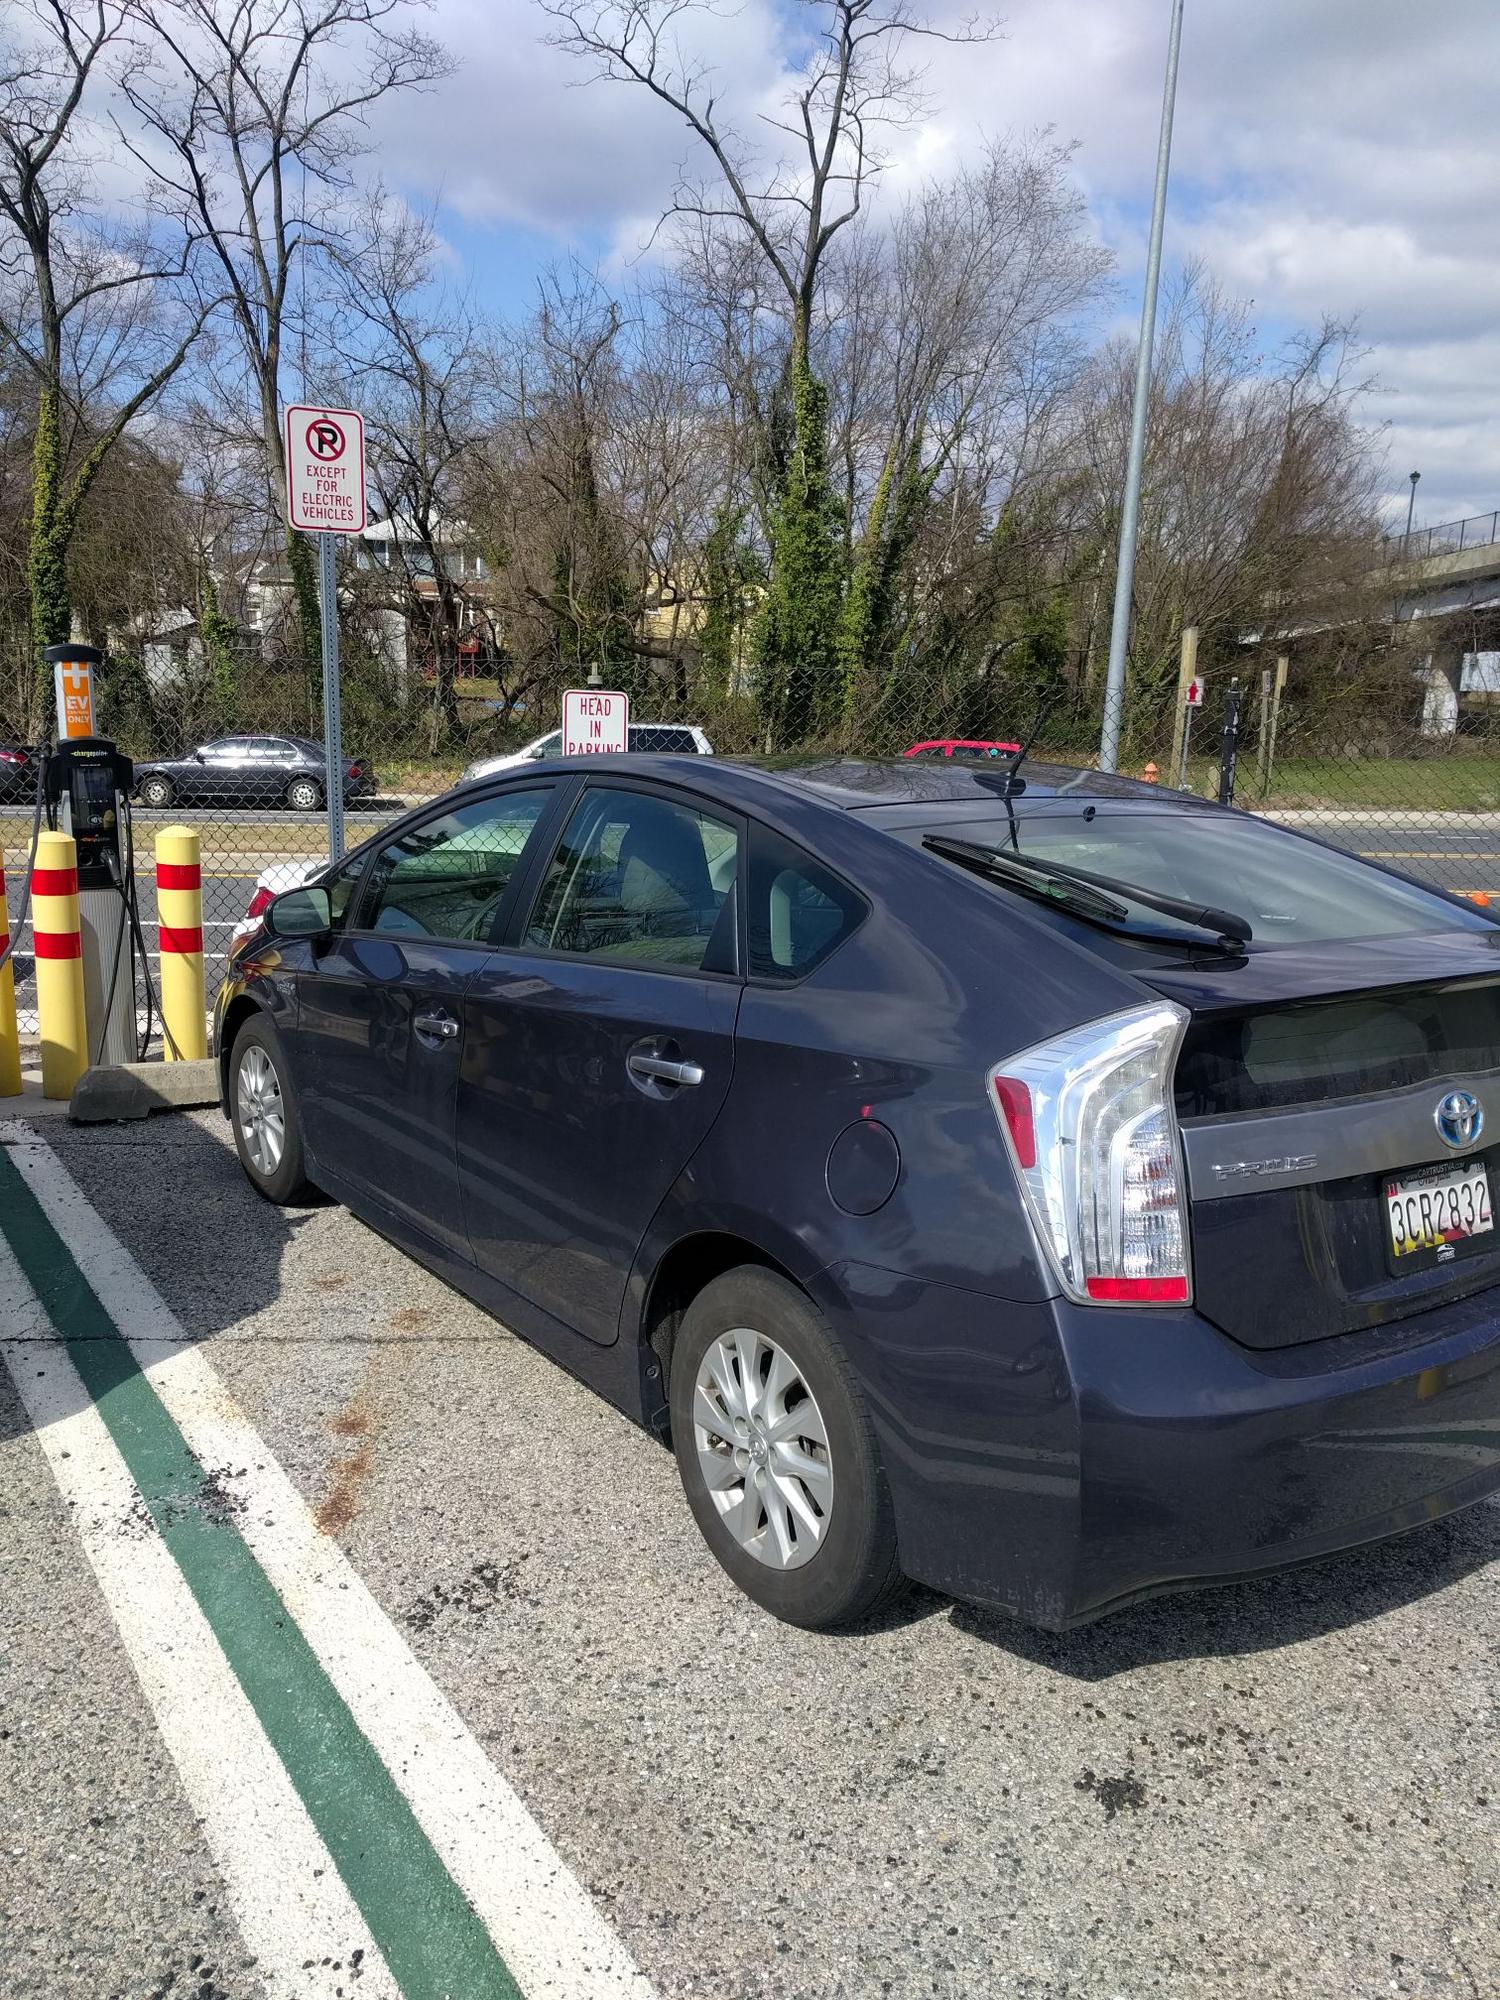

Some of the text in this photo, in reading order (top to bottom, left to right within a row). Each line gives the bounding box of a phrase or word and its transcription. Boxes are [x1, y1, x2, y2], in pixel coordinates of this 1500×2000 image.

[306, 465, 346, 479] EXCEPT
[316, 480, 338, 492] FOR
[302, 493, 352, 507] ELECTRIC
[302, 507, 354, 520] VEHICLES
[67, 695, 89, 709] EV
[580, 697, 611, 716] HEAD
[67, 715, 90, 723] ONLY
[590, 720, 601, 738] IN
[1211, 1154, 1319, 1181] PRIUS
[1391, 1180, 1491, 1246] 3CR2832
